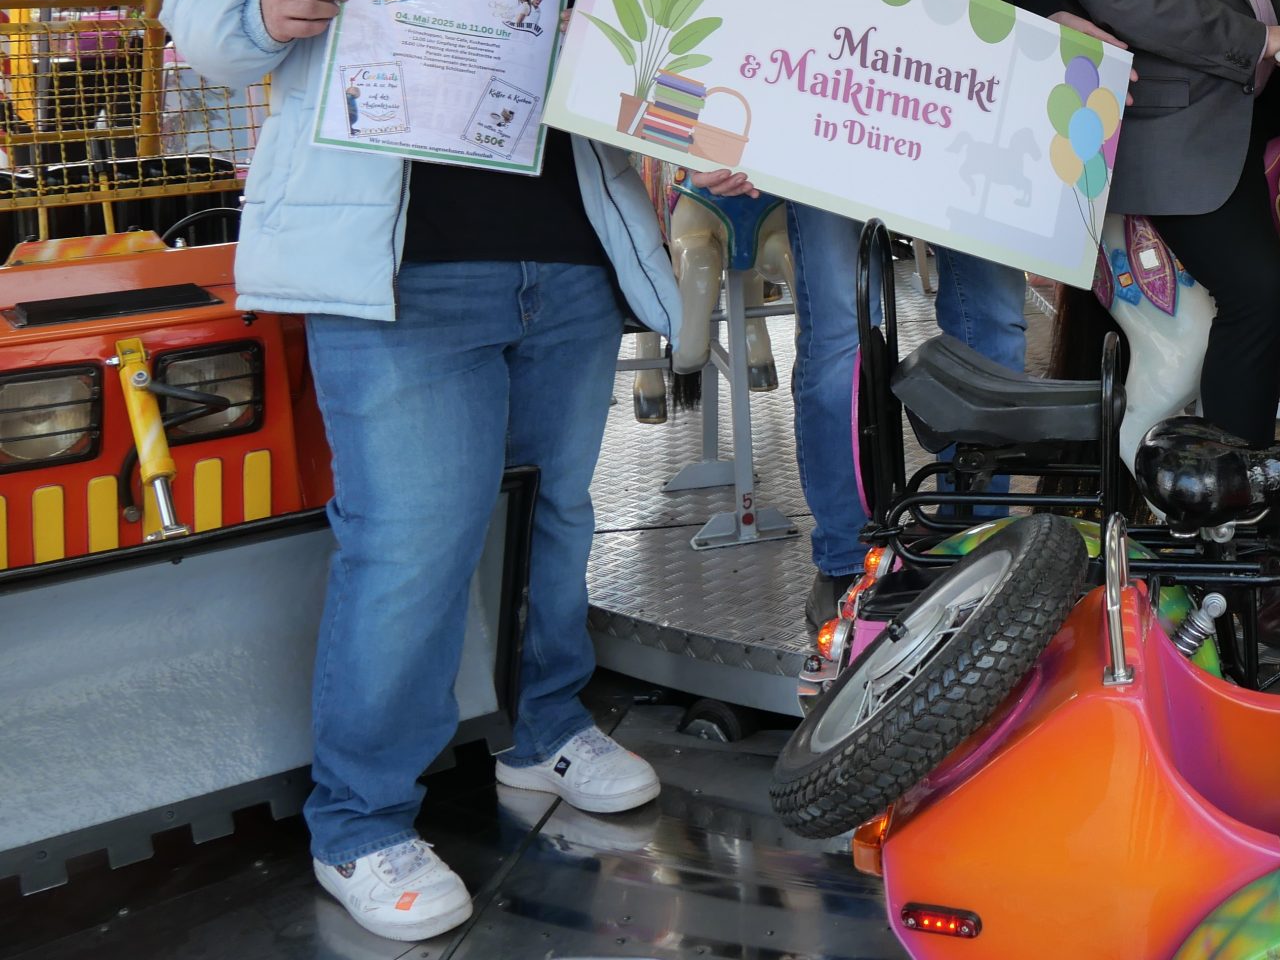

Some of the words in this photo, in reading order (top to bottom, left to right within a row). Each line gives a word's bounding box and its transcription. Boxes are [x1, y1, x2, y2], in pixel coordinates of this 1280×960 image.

[395, 11, 410, 20] 04.
[413, 14, 430, 24] Mai
[432, 17, 454, 28] 2025
[456, 22, 467, 30] ab
[470, 24, 494, 35] 11.00
[496, 29, 512, 38] Uhr
[828, 26, 1000, 112] Maimarkt
[740, 55, 761, 79] &
[765, 49, 952, 128] Maikirmes
[474, 132, 505, 148] 3,50€
[814, 113, 837, 141] in
[843, 119, 922, 160] Düren
[743, 492, 752, 510] 5
